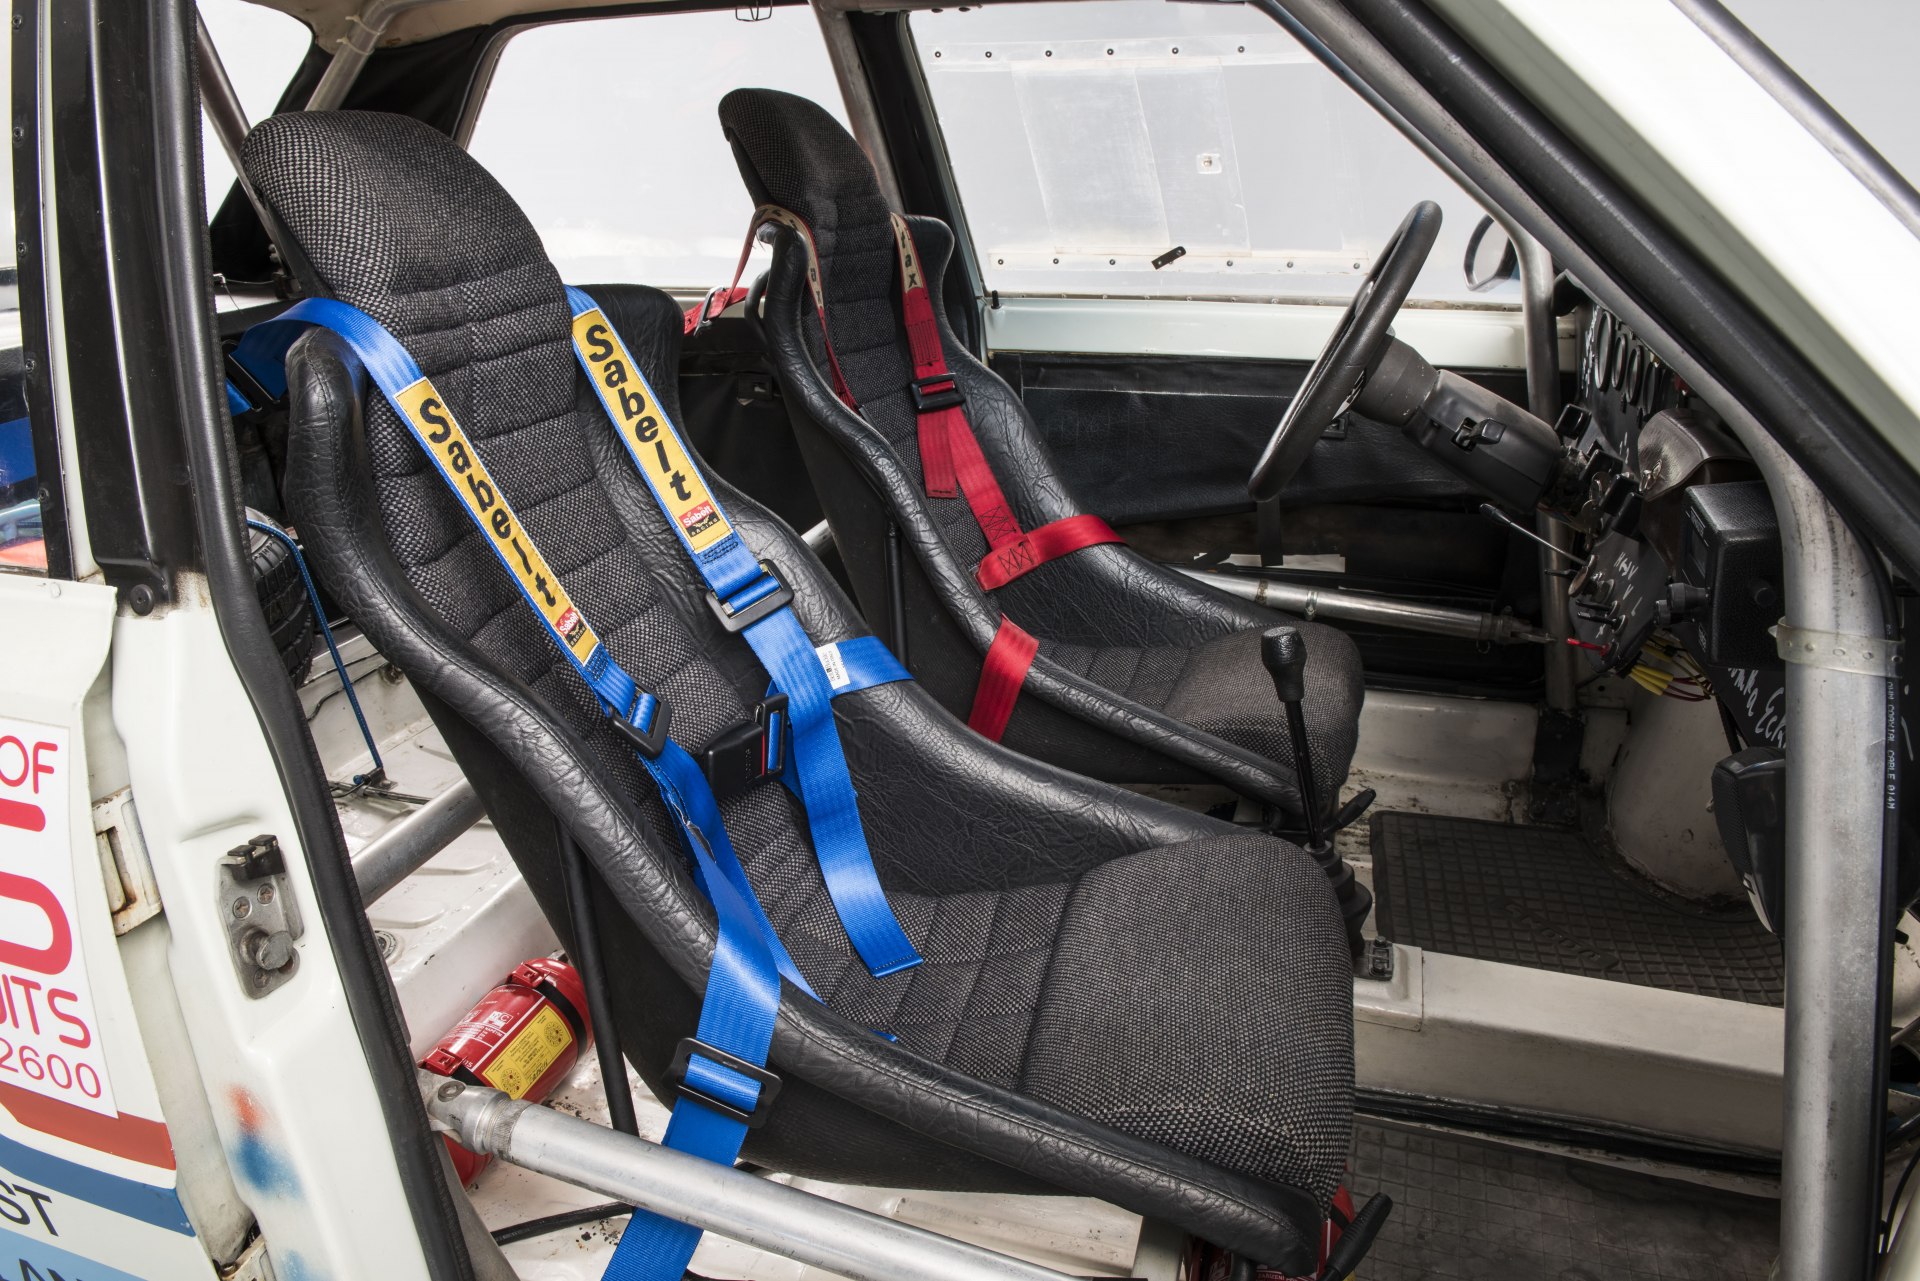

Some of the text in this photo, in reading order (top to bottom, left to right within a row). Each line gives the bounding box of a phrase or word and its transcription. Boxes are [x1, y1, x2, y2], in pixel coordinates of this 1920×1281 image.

[585, 324, 692, 502] Sabelt
[420, 397, 556, 609] Sabelt
[682, 504, 713, 527] Sabelt
[690, 517, 719, 537] RACING
[559, 611, 580, 635] Sabelt
[1887, 704, 1895, 743] COAXIAL
[0, 735, 58, 794] OF
[1887, 750, 1896, 781] CABLE
